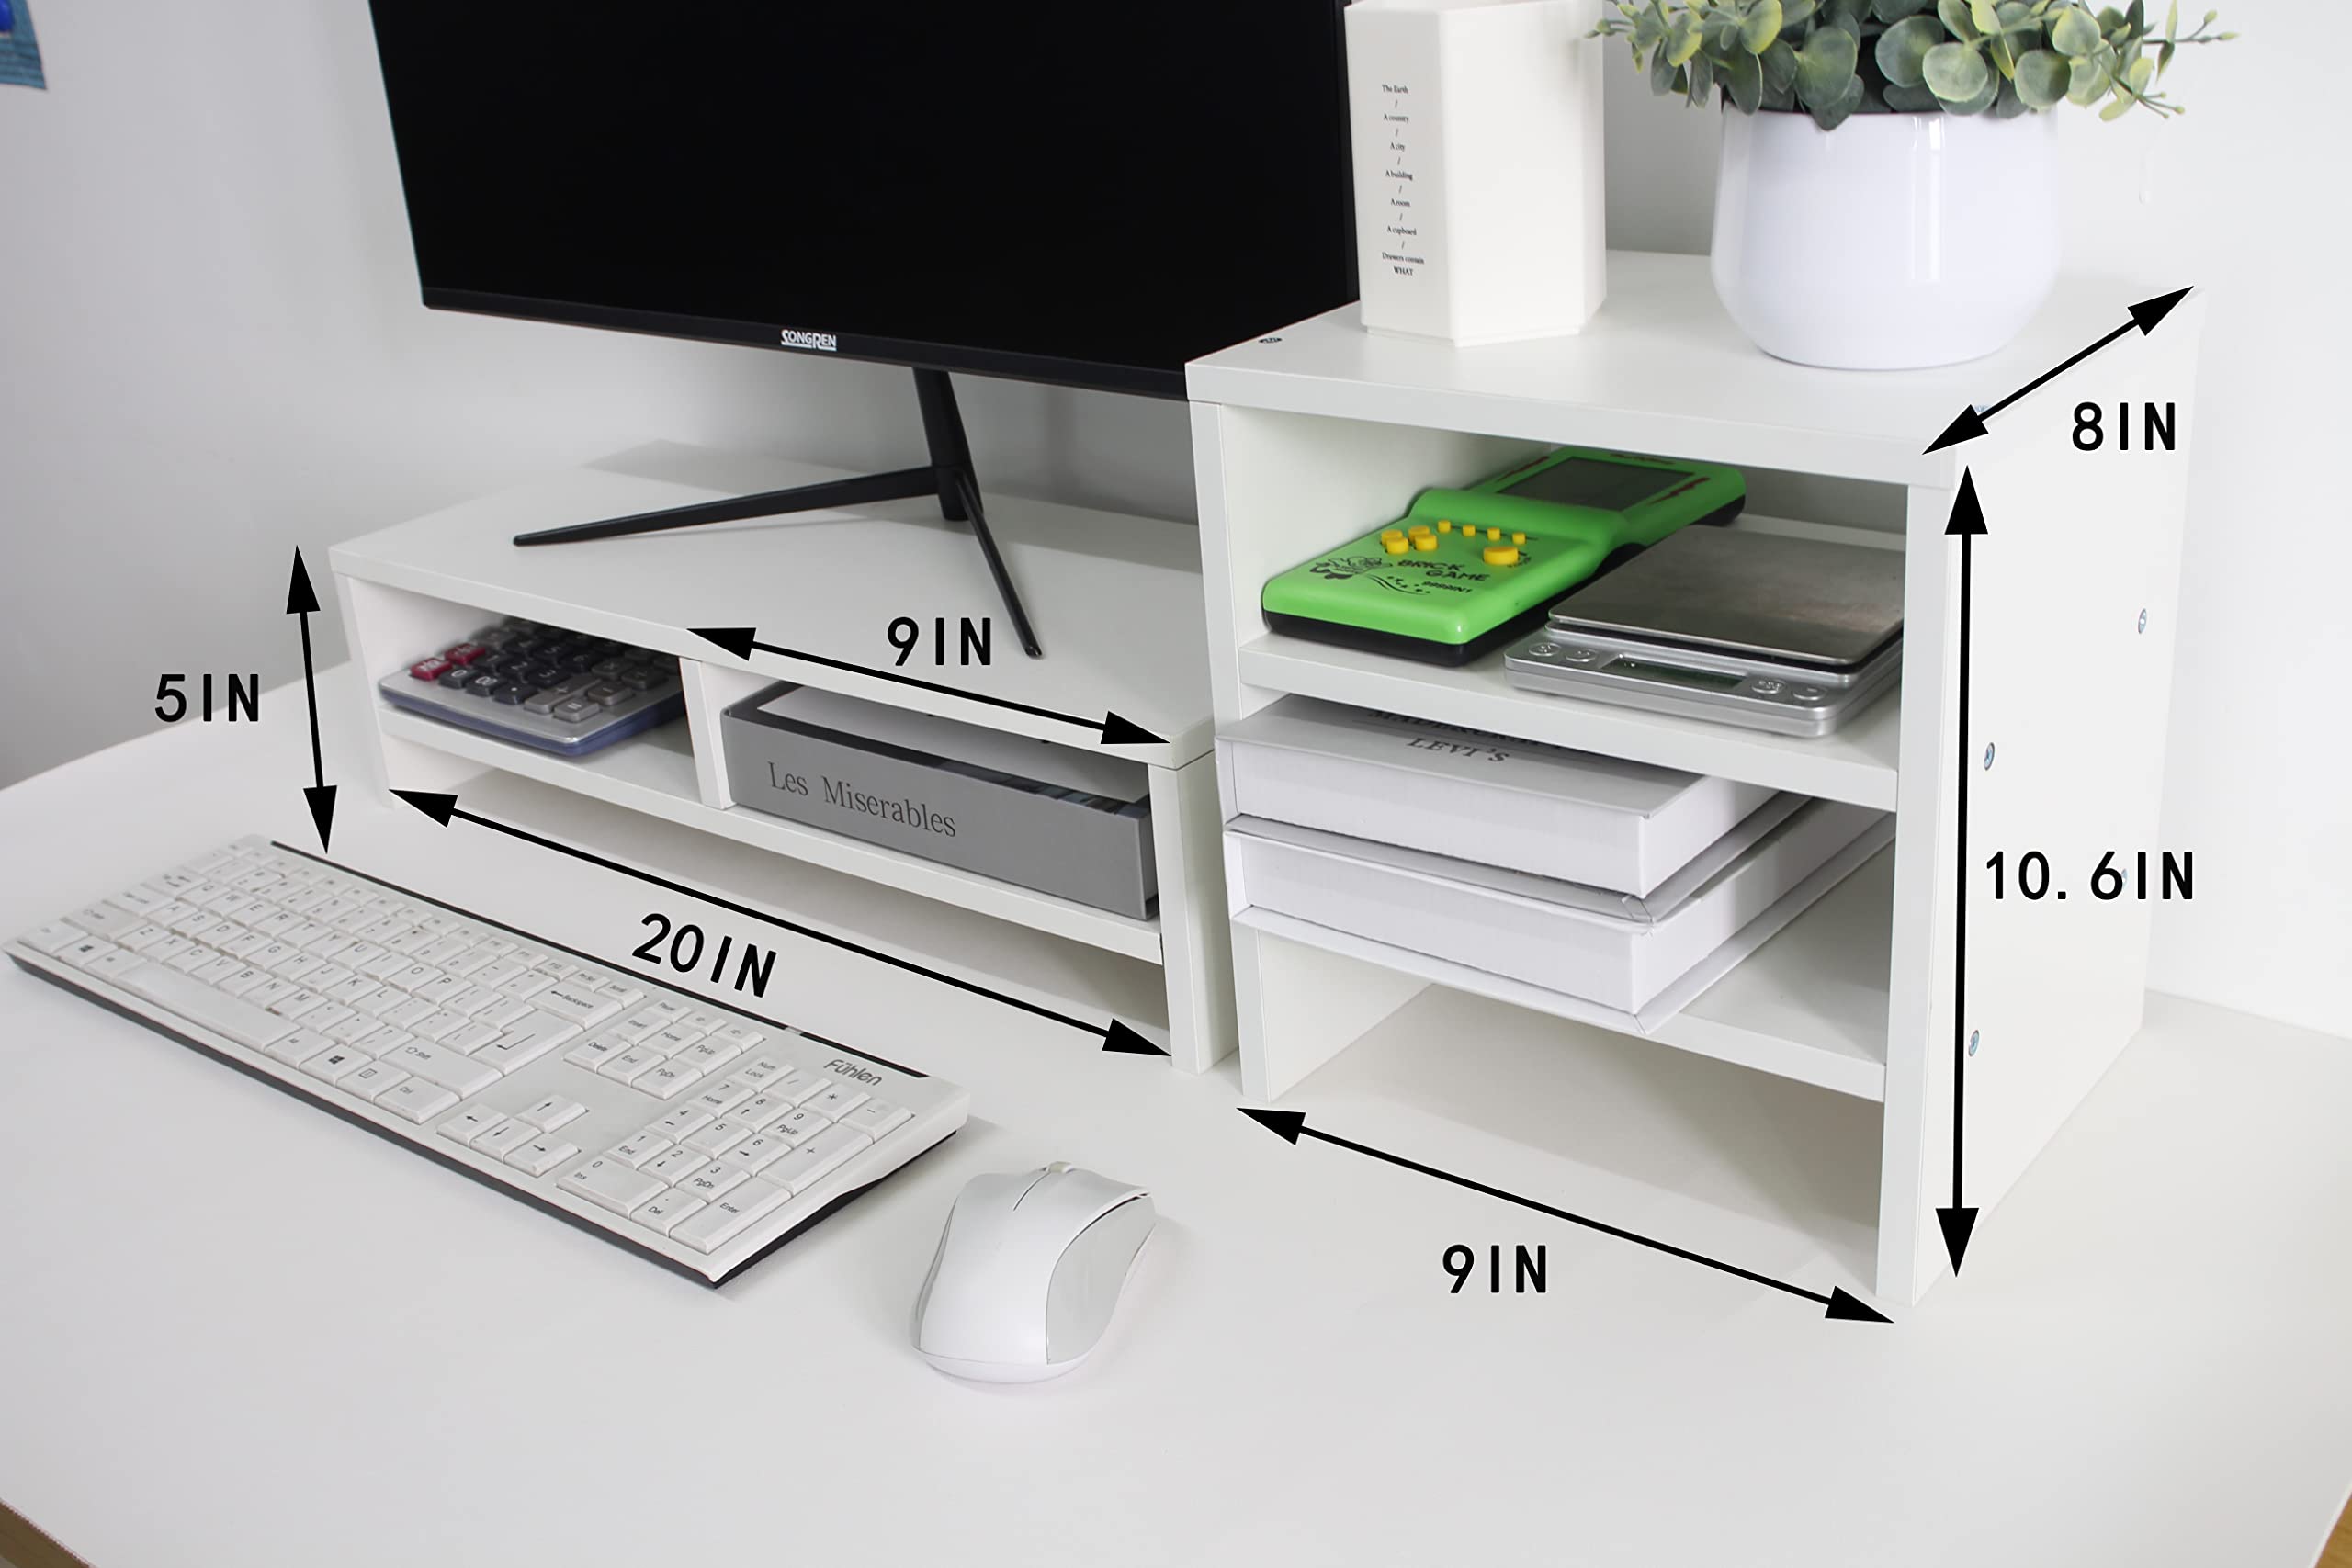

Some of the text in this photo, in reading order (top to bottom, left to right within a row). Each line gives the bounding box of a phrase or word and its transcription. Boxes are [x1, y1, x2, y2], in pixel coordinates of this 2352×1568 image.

[1382, 85, 1408, 94] The Earth
[1389, 115, 1409, 124] country
[1396, 142, 1406, 152] city
[1391, 170, 1413, 181] building
[1393, 226, 1417, 236] cupboard
[1382, 253, 1424, 265] Drawers contain
[1394, 266, 1414, 276] WHAT
[780, 329, 837, 351] SONGREN
[1396, 558, 1465, 572] BRICK
[1426, 570, 1490, 581] GAME
[1407, 737, 1510, 763] LEVI'S
[767, 761, 956, 838] Les Miserables
[562, 994, 594, 1009] Backspace
[662, 1032, 681, 1042] Home
[588, 1041, 608, 1053] Delete
[622, 1055, 638, 1064] End
[757, 1060, 776, 1070] Num
[745, 1068, 764, 1079] Lock
[702, 1094, 723, 1105] Home
[618, 1145, 636, 1155] End
[694, 1177, 715, 1190] PgDn
[648, 1205, 664, 1215] Del
[719, 1201, 741, 1213] Enter
